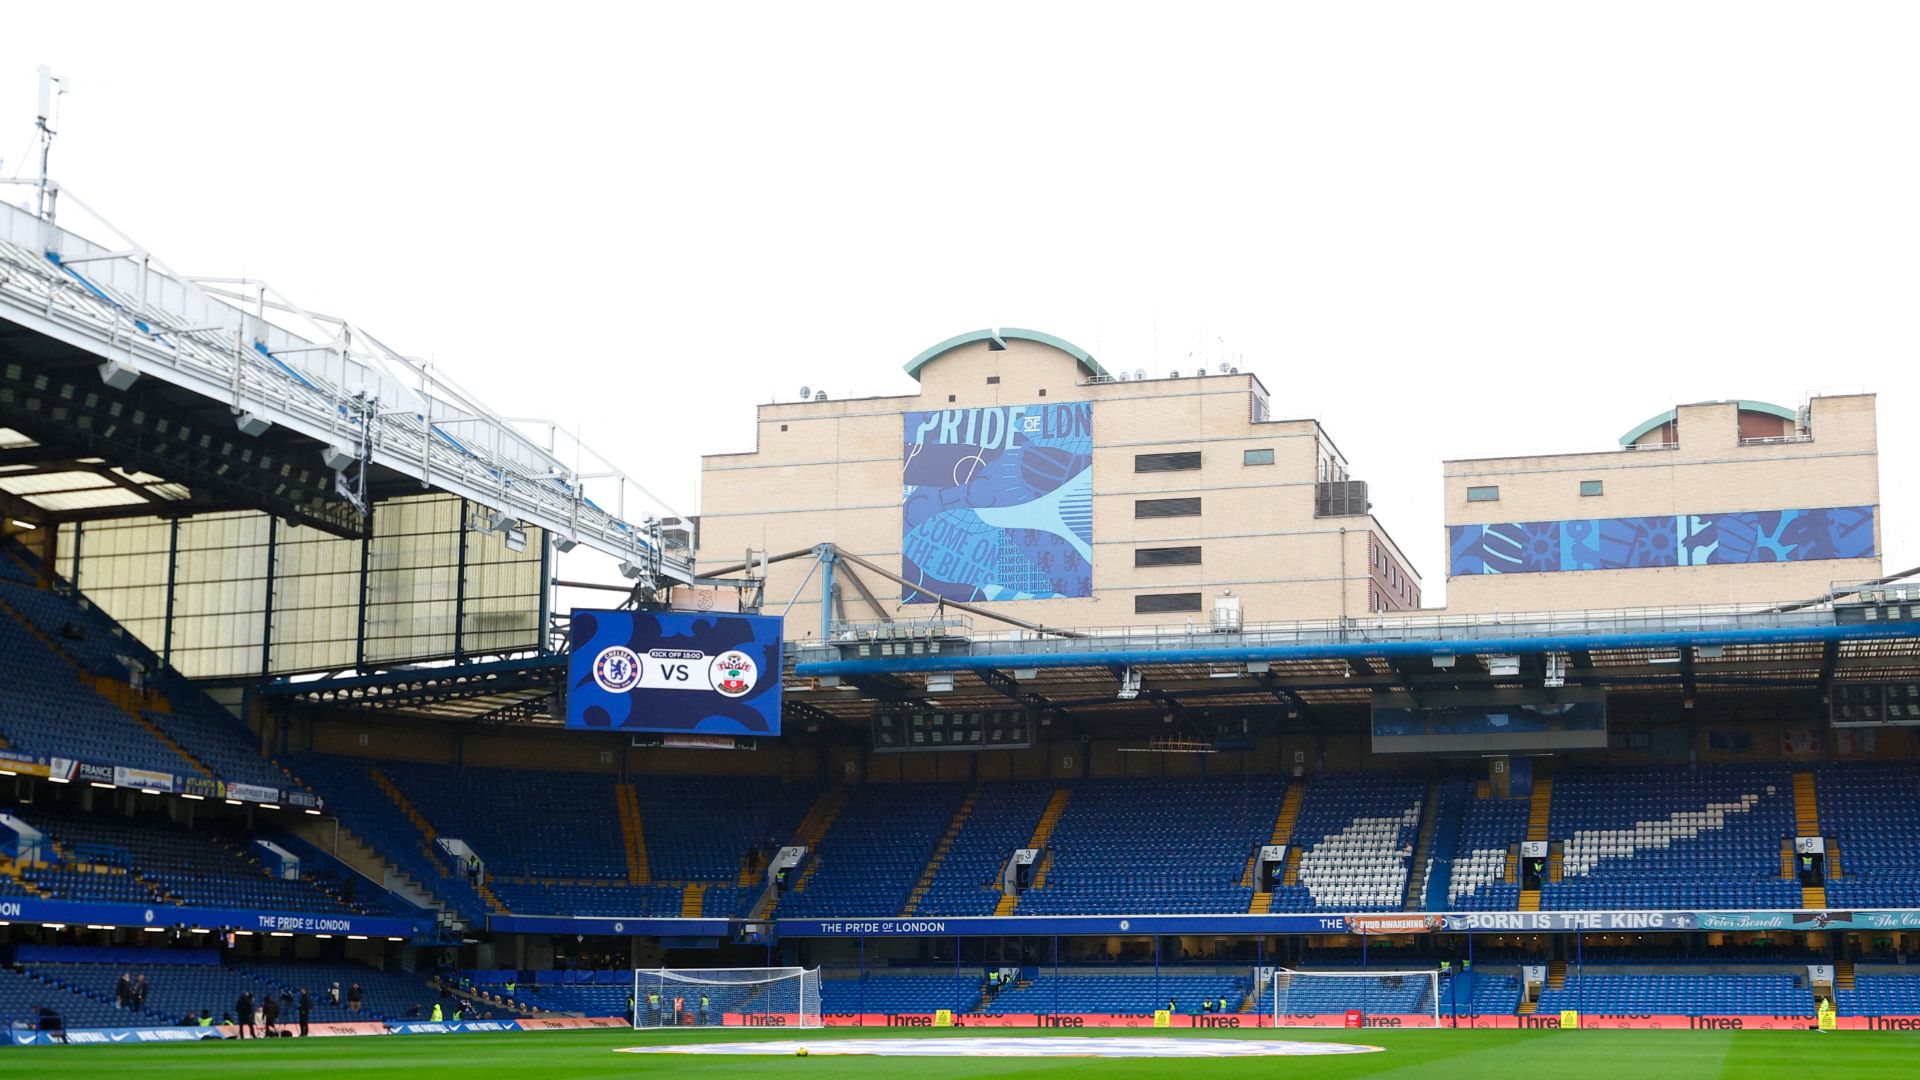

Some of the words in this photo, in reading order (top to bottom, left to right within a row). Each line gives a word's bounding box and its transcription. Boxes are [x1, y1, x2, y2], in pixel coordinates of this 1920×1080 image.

[917, 407, 1025, 450] PRIDE
[1024, 417, 1040, 431] OF
[1042, 405, 1091, 439] LDN
[920, 517, 971, 556] COME
[972, 538, 998, 570] ON
[905, 534, 939, 569] THE
[998, 565, 1028, 574] STAMFORD
[998, 574, 1028, 583] STAMFORD
[604, 650, 631, 660] CHELSEA
[661, 664, 689, 681] VS
[80, 764, 112, 777] FRANCE
[1531, 843, 1539, 852] 5
[1805, 838, 1813, 848] 6
[791, 848, 798, 856] 2
[1025, 850, 1031, 859] 3
[1271, 847, 1278, 855] 4
[259, 916, 275, 927] THE
[278, 917, 303, 929] PRIDE
[305, 919, 314, 928] OF
[315, 920, 350, 931] LONDON
[821, 923, 842, 933] THE
[882, 922, 893, 932] OF
[896, 922, 945, 932] LONDON
[1319, 919, 1343, 929] THE
[1381, 920, 1424, 929] AWAKENING
[1467, 914, 1524, 929] BORN
[1532, 914, 1551, 928] IS
[1560, 914, 1602, 928] THE
[1611, 913, 1664, 928] KING
[1704, 915, 1734, 927] Peter
[1737, 915, 1784, 927] Bonetti
[1532, 967, 1539, 975] 5
[1817, 965, 1824, 974] 6
[740, 1013, 786, 1026] Three
[884, 1014, 932, 1027] Three
[1033, 1014, 1084, 1027] Three
[1188, 1014, 1240, 1028] Three
[1362, 1014, 1402, 1027] hree
[1516, 1015, 1561, 1028] Thre
[1686, 1015, 1743, 1029] Three
[1863, 1016, 1920, 1030] Three
